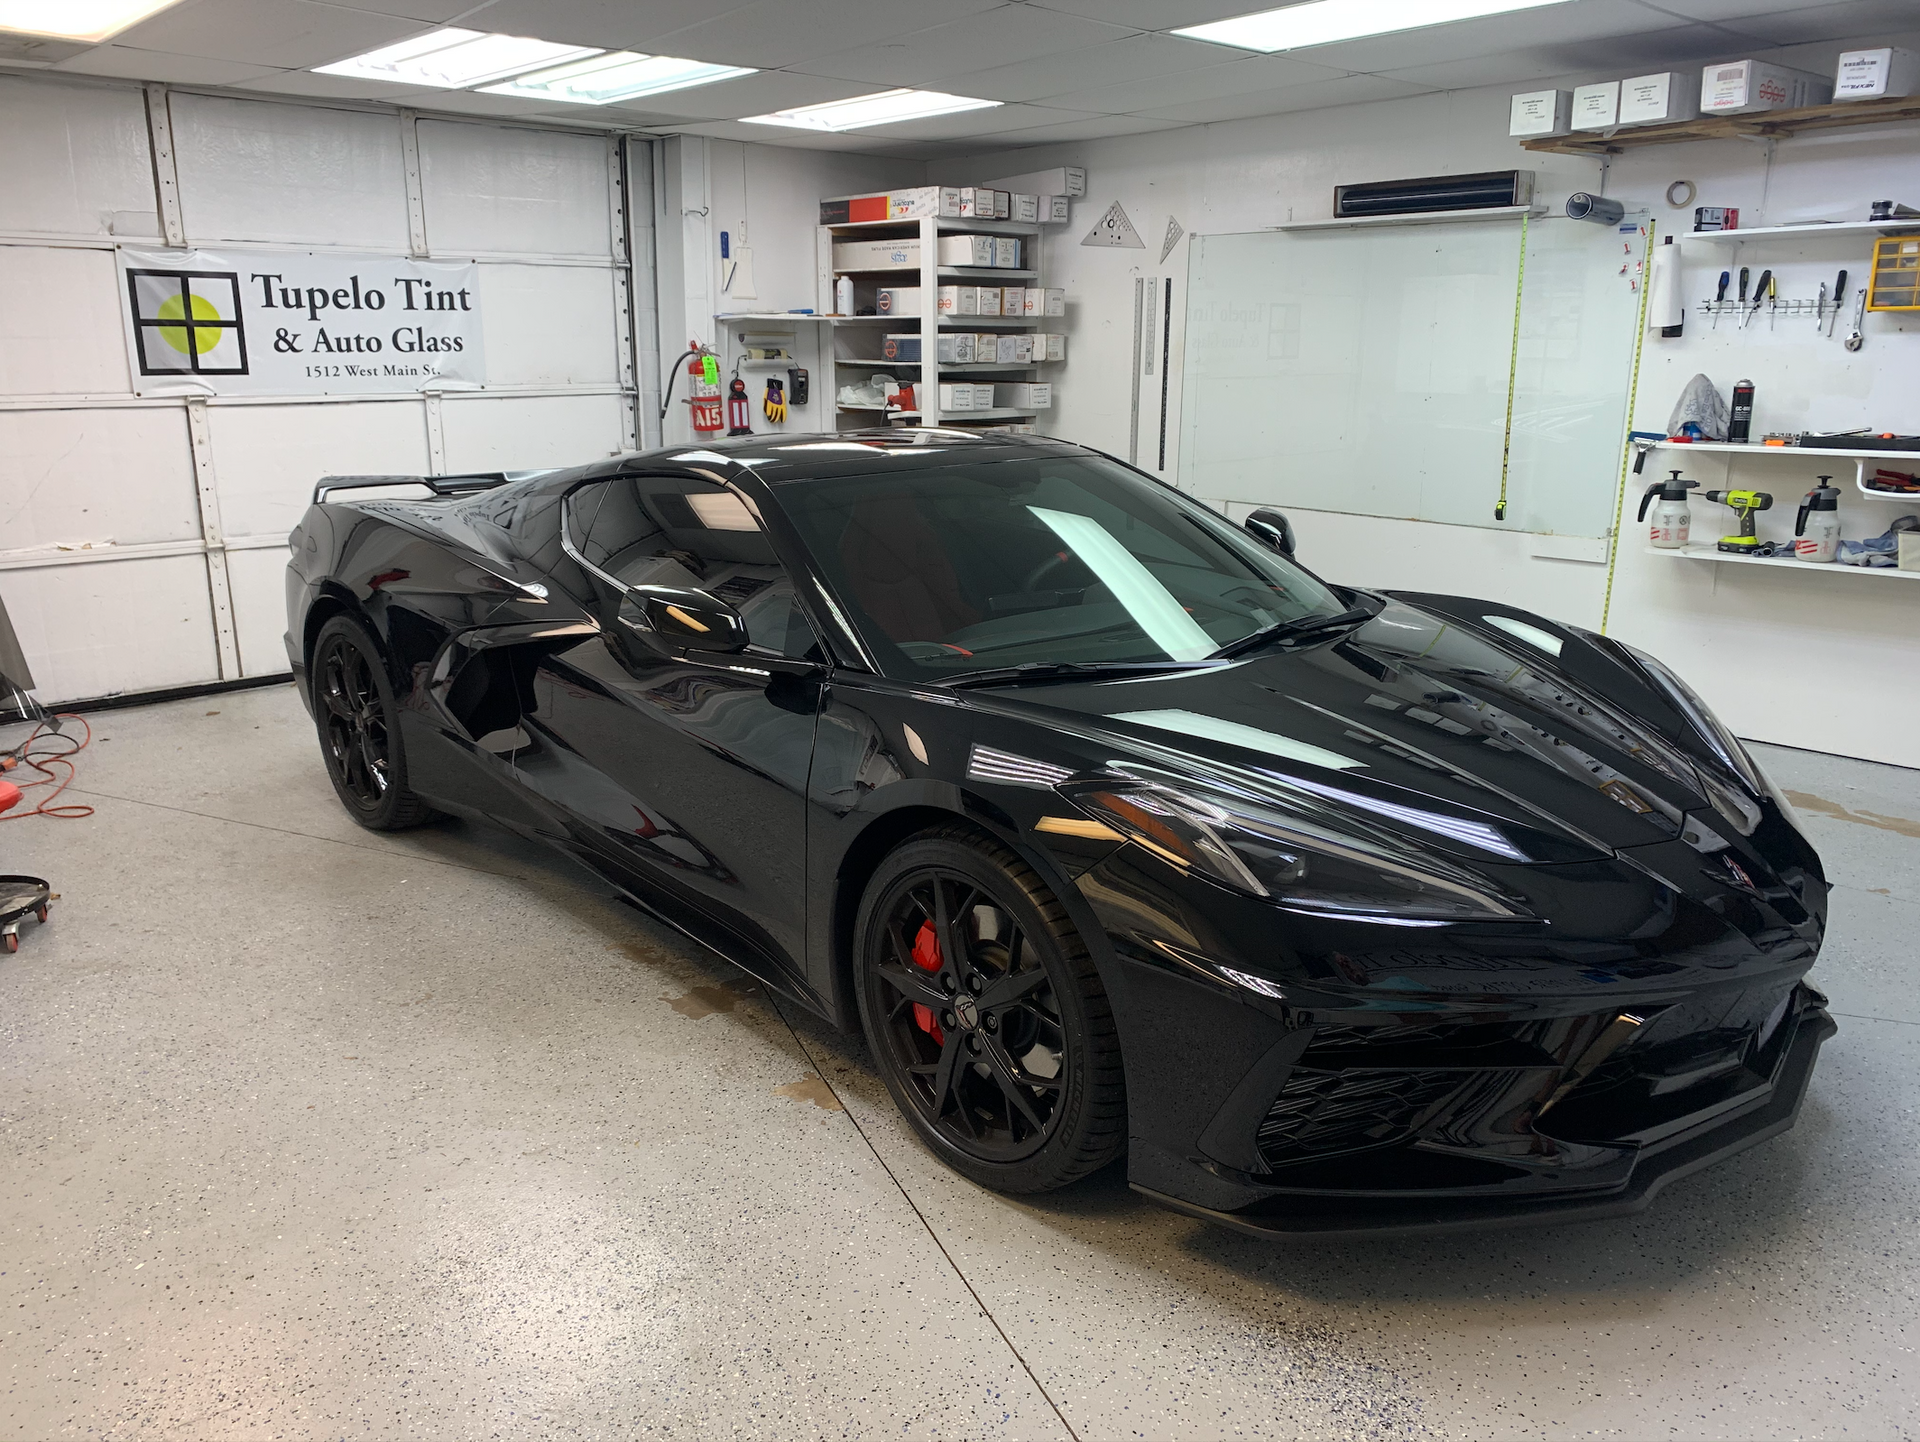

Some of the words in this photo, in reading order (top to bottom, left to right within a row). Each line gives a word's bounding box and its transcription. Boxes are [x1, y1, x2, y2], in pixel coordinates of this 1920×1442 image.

[1758, 79, 1787, 104] edge
[251, 272, 386, 321] Tupelo
[394, 277, 472, 311] Tint
[273, 327, 304, 353] &
[311, 327, 382, 353] Auto
[391, 326, 464, 352] Glass
[304, 365, 341, 377] 1512
[344, 365, 378, 377] West
[382, 364, 418, 377] Main
[422, 364, 441, 377] St.
